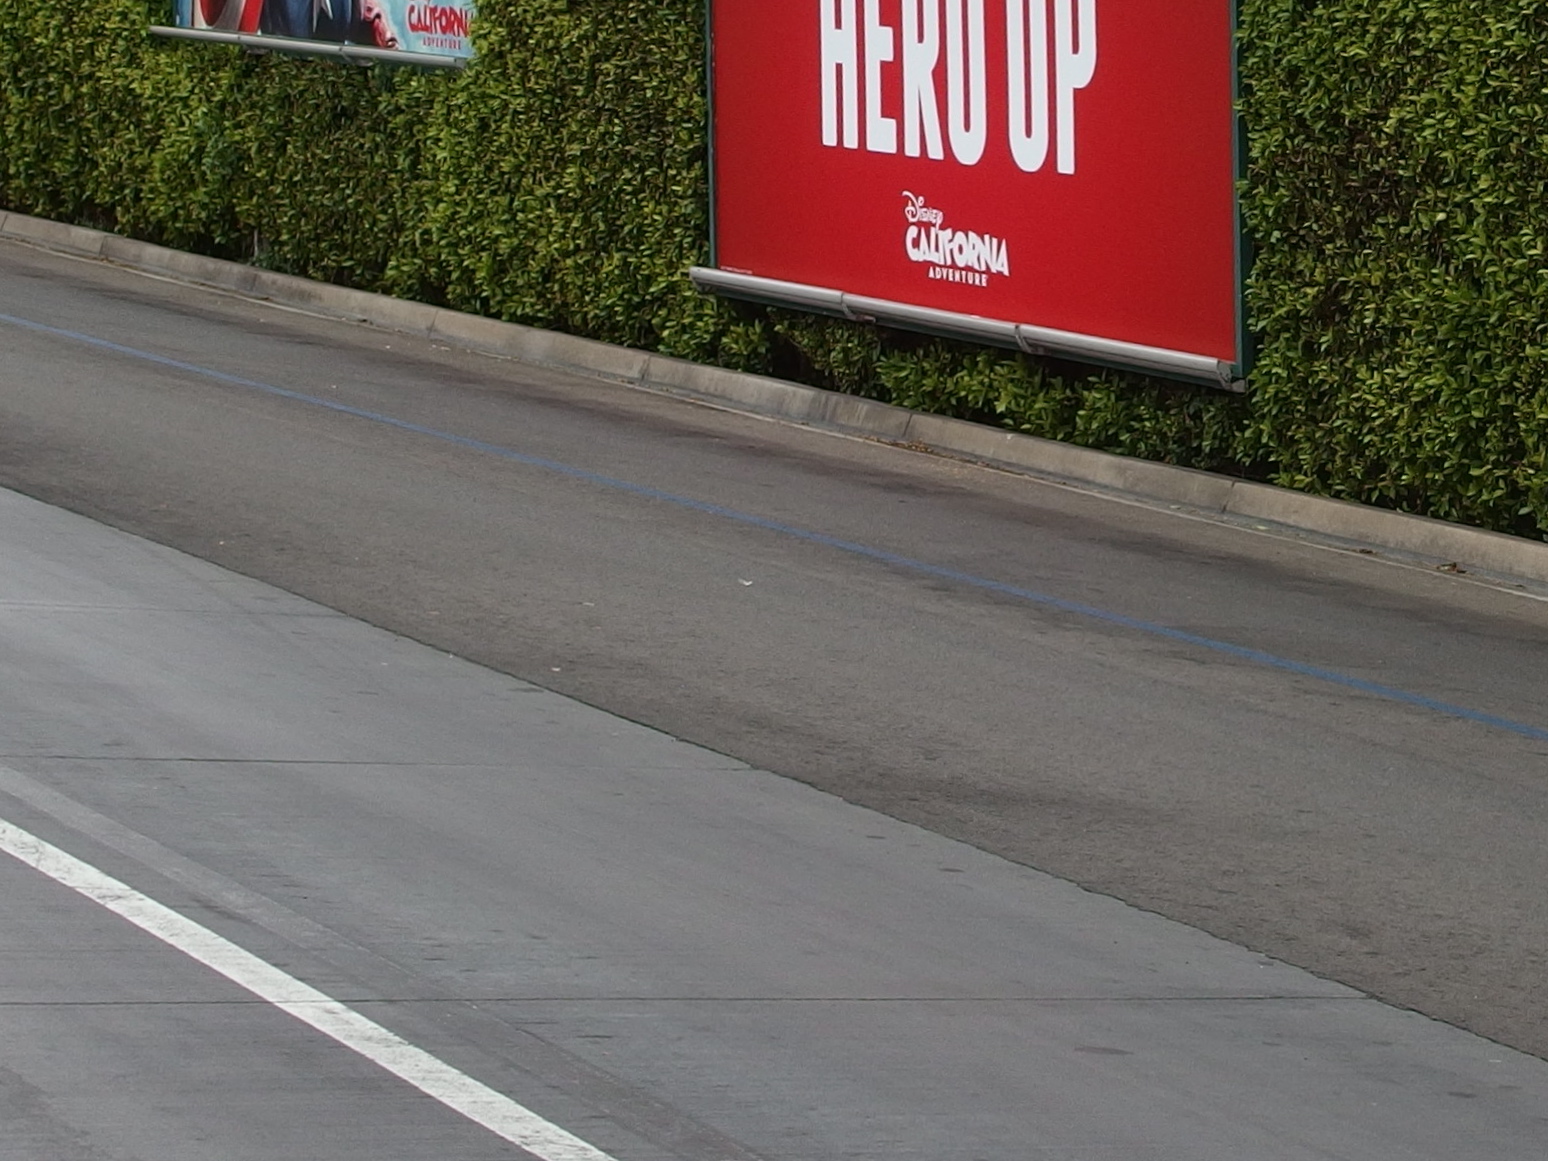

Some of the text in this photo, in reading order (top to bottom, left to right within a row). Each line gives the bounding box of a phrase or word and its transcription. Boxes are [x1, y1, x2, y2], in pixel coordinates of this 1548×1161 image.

[408, 4, 474, 38] CALIFORNI
[905, 224, 1010, 277] CALIFORNIA
[928, 266, 988, 287] ADVENTURE
